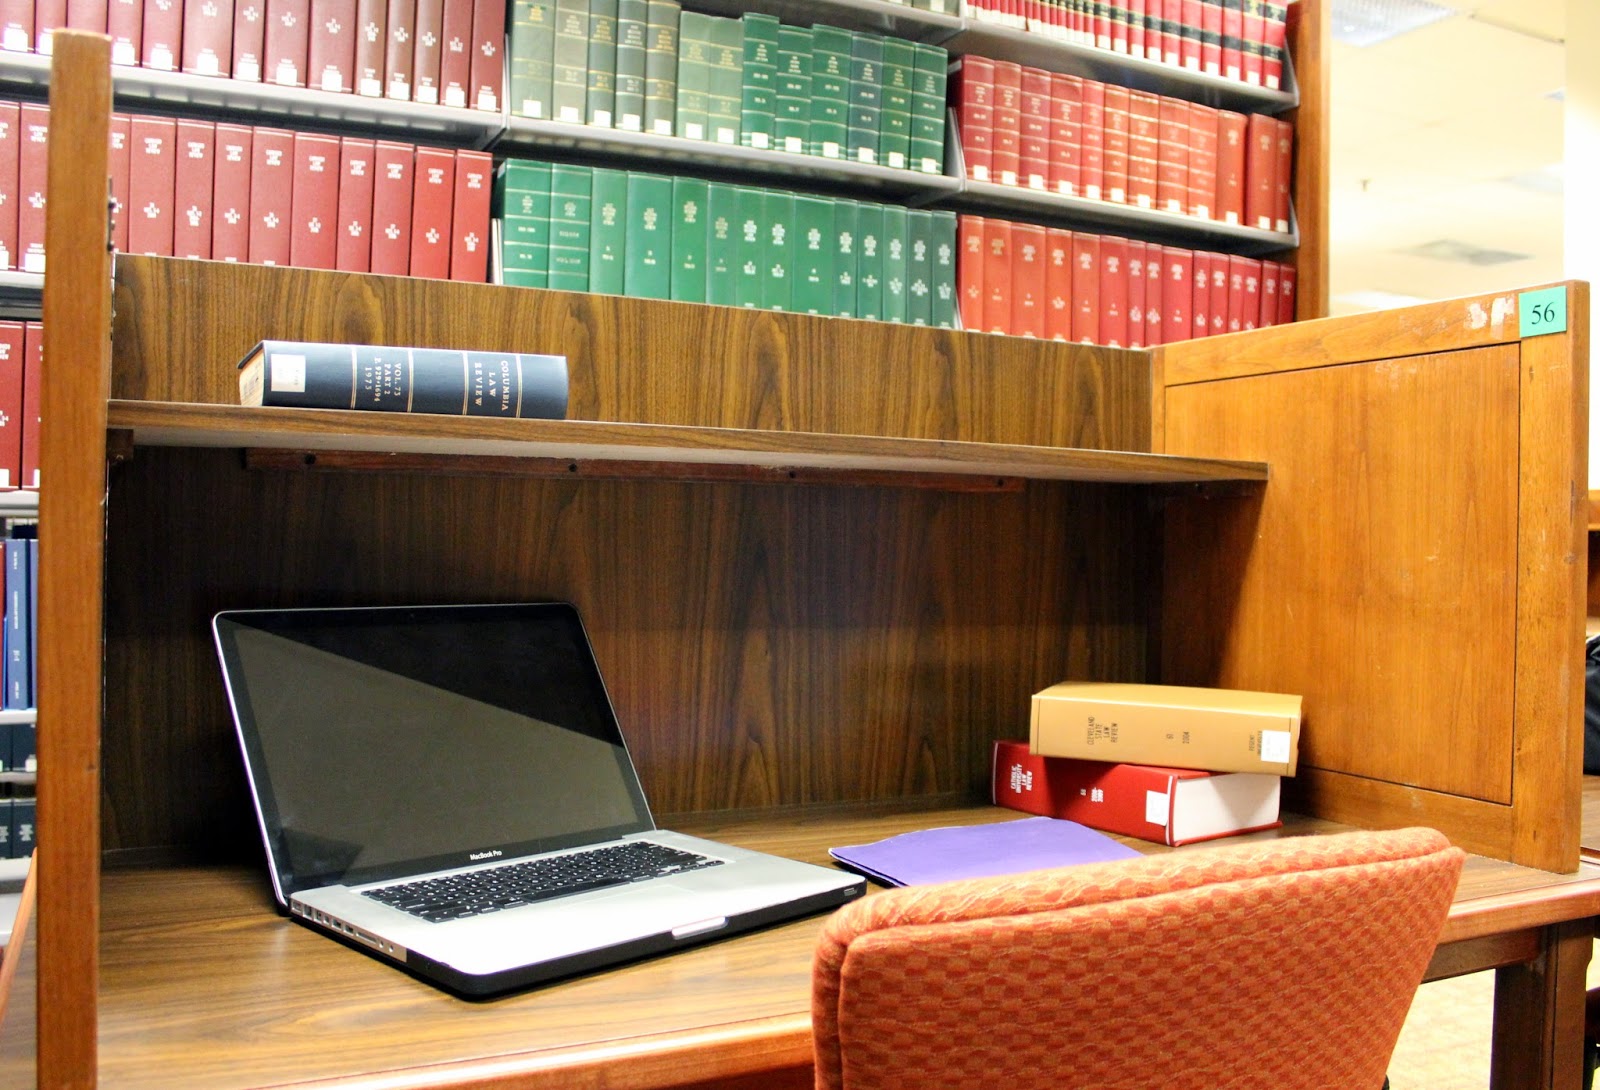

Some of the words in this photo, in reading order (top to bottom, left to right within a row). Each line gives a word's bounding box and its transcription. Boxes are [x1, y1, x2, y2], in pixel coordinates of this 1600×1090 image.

[1531, 302, 1555, 325] 56
[384, 363, 392, 387] PART
[394, 362, 402, 384] VOL.
[474, 362, 483, 406] REVIEW
[488, 371, 497, 397] LAW
[394, 386, 402, 396] 73
[500, 360, 510, 411] COLUMBIA
[1087, 716, 1095, 745] CLEVELAND
[1095, 723, 1103, 740] STATE
[470, 851, 493, 860] MacBook
